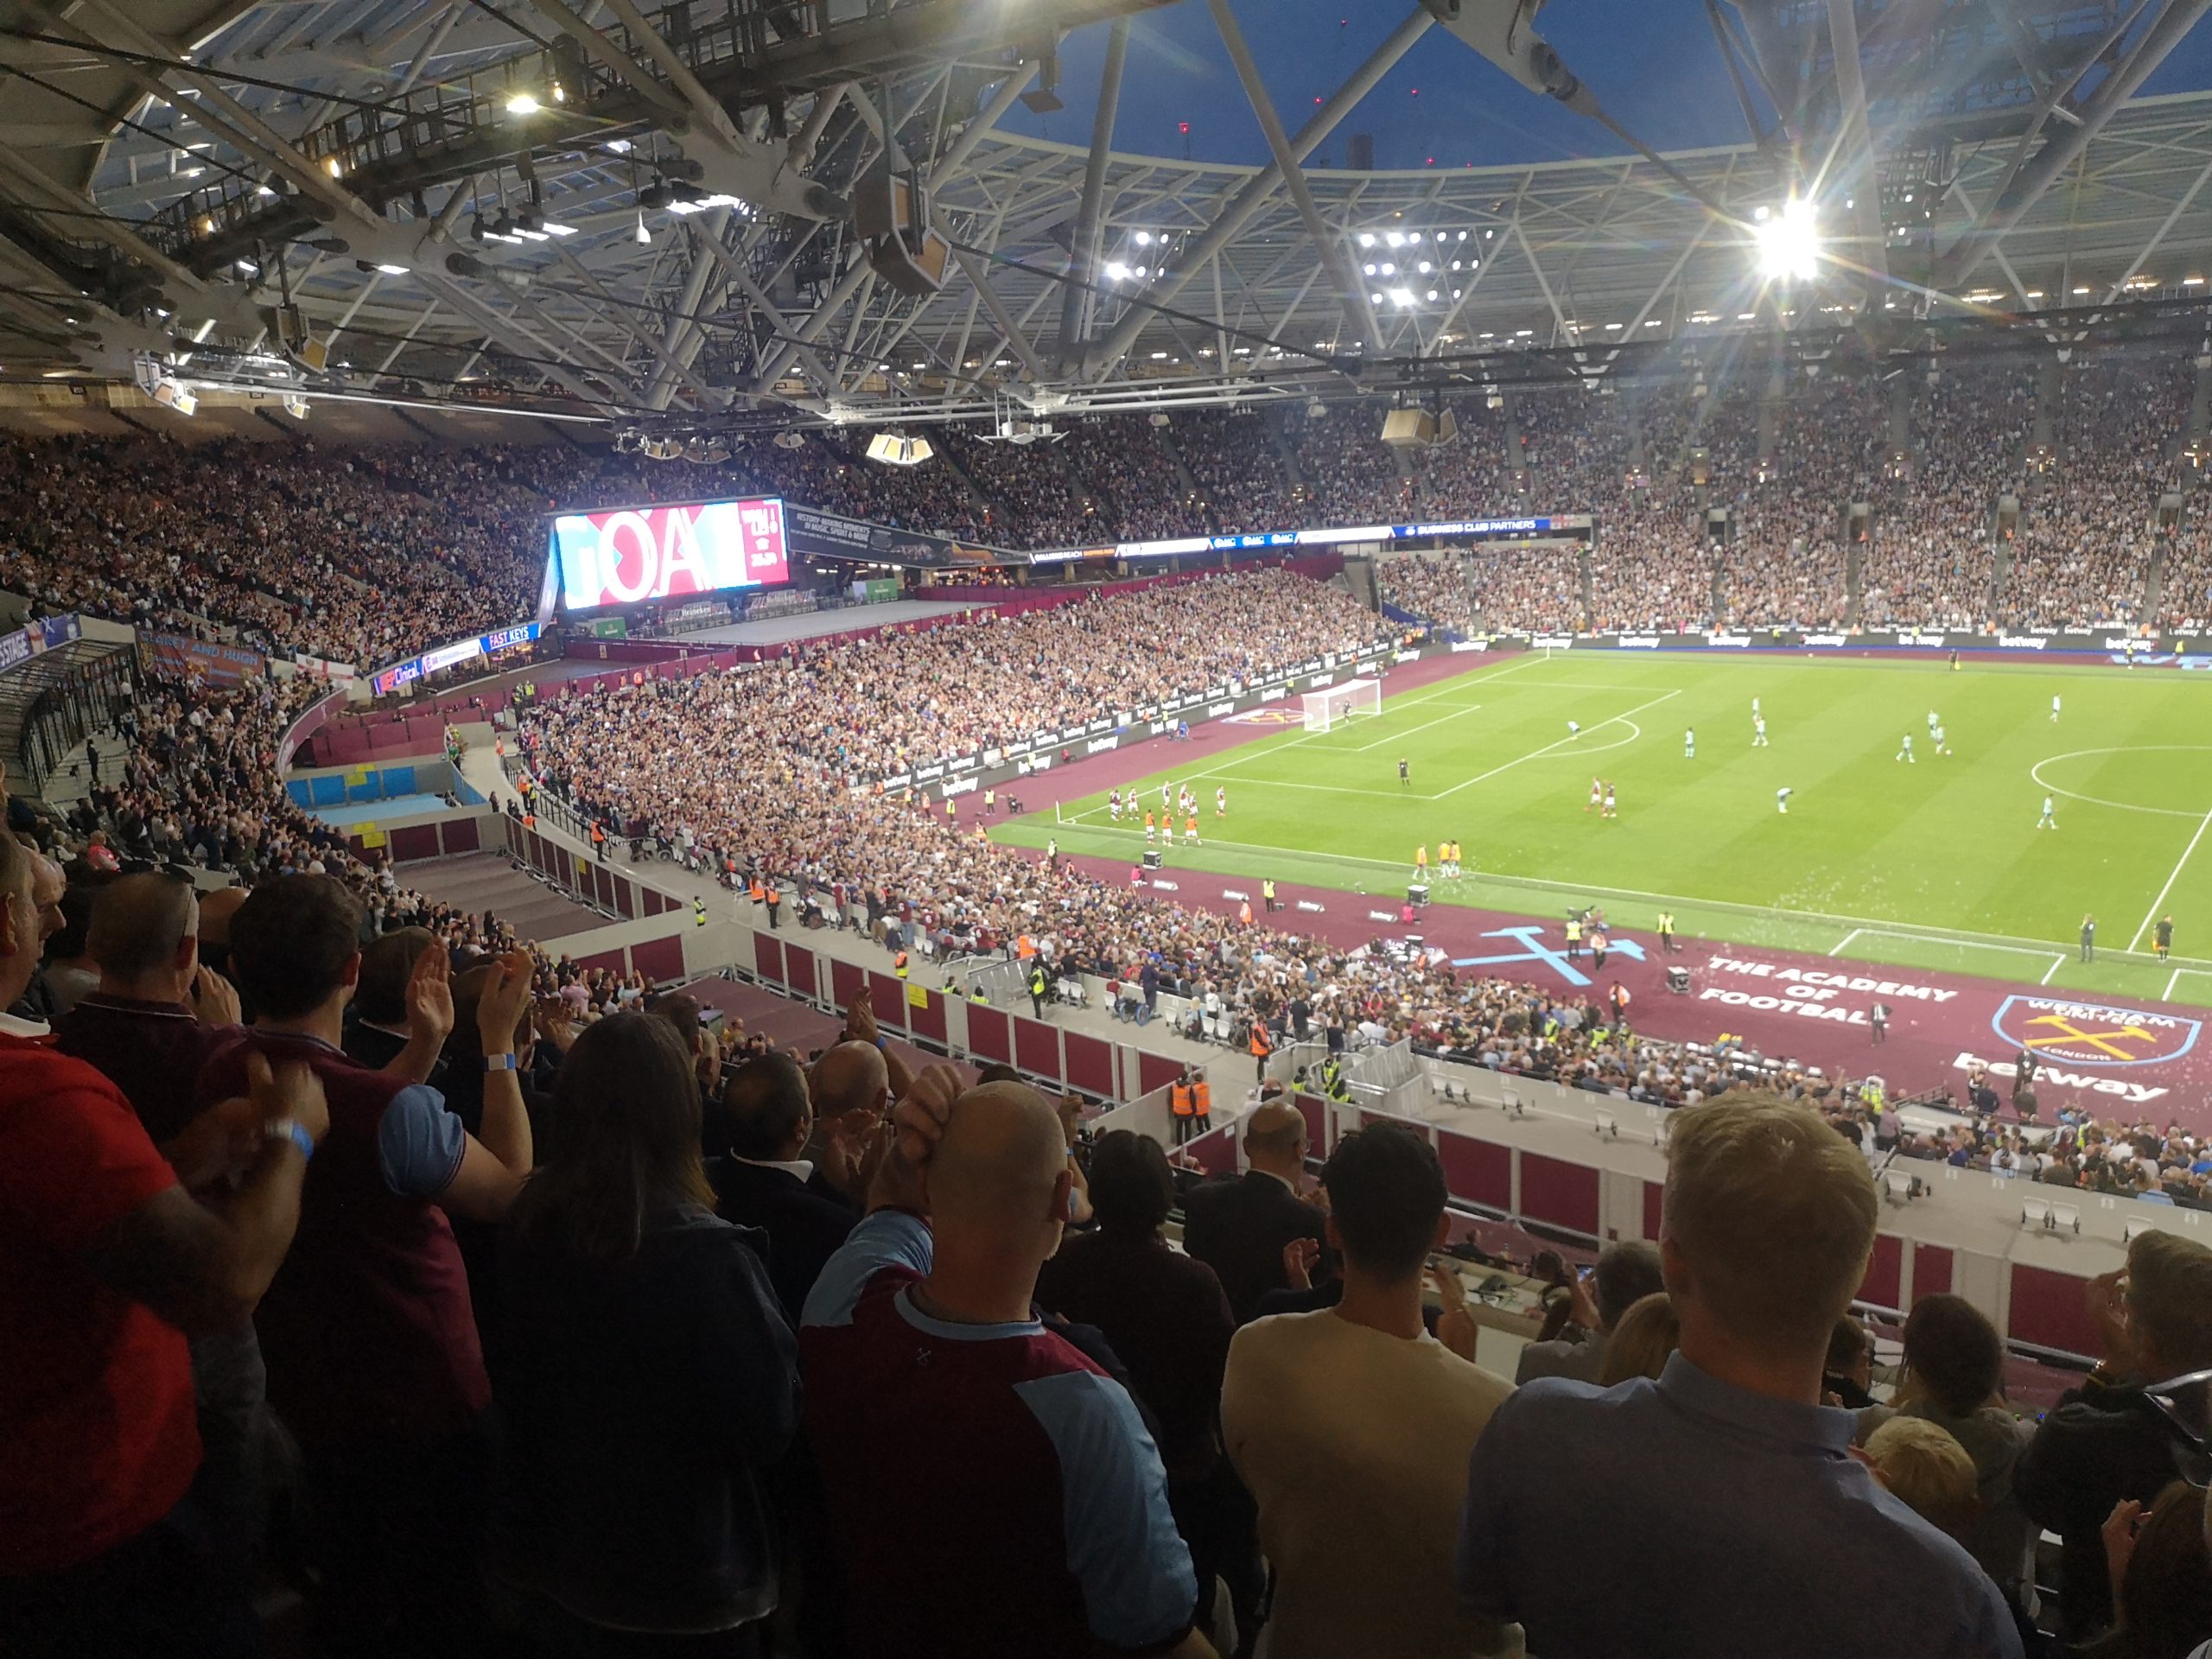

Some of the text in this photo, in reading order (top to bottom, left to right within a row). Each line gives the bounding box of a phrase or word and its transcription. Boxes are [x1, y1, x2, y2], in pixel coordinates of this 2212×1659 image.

[1417, 520, 1536, 535] BUSINESS CLUB PARTNERS
[489, 626, 529, 647] FAST KEYS
[2031, 626, 2058, 635] betway
[2064, 627, 2093, 636] betway
[1618, 636, 1661, 648] betway
[1708, 635, 1751, 647] betway
[1999, 635, 2047, 650] betway
[1087, 735, 1118, 753] betway
[1019, 755, 1052, 774] beway
[917, 766, 944, 779] betway
[883, 774, 912, 789] betway
[942, 777, 978, 797] betway
[1708, 957, 1959, 1002] THE ACADEMY
[1785, 985, 1839, 1001] OF
[1700, 988, 1890, 1029] FOOTBAL
[2042, 1046, 2111, 1062] LONDON
